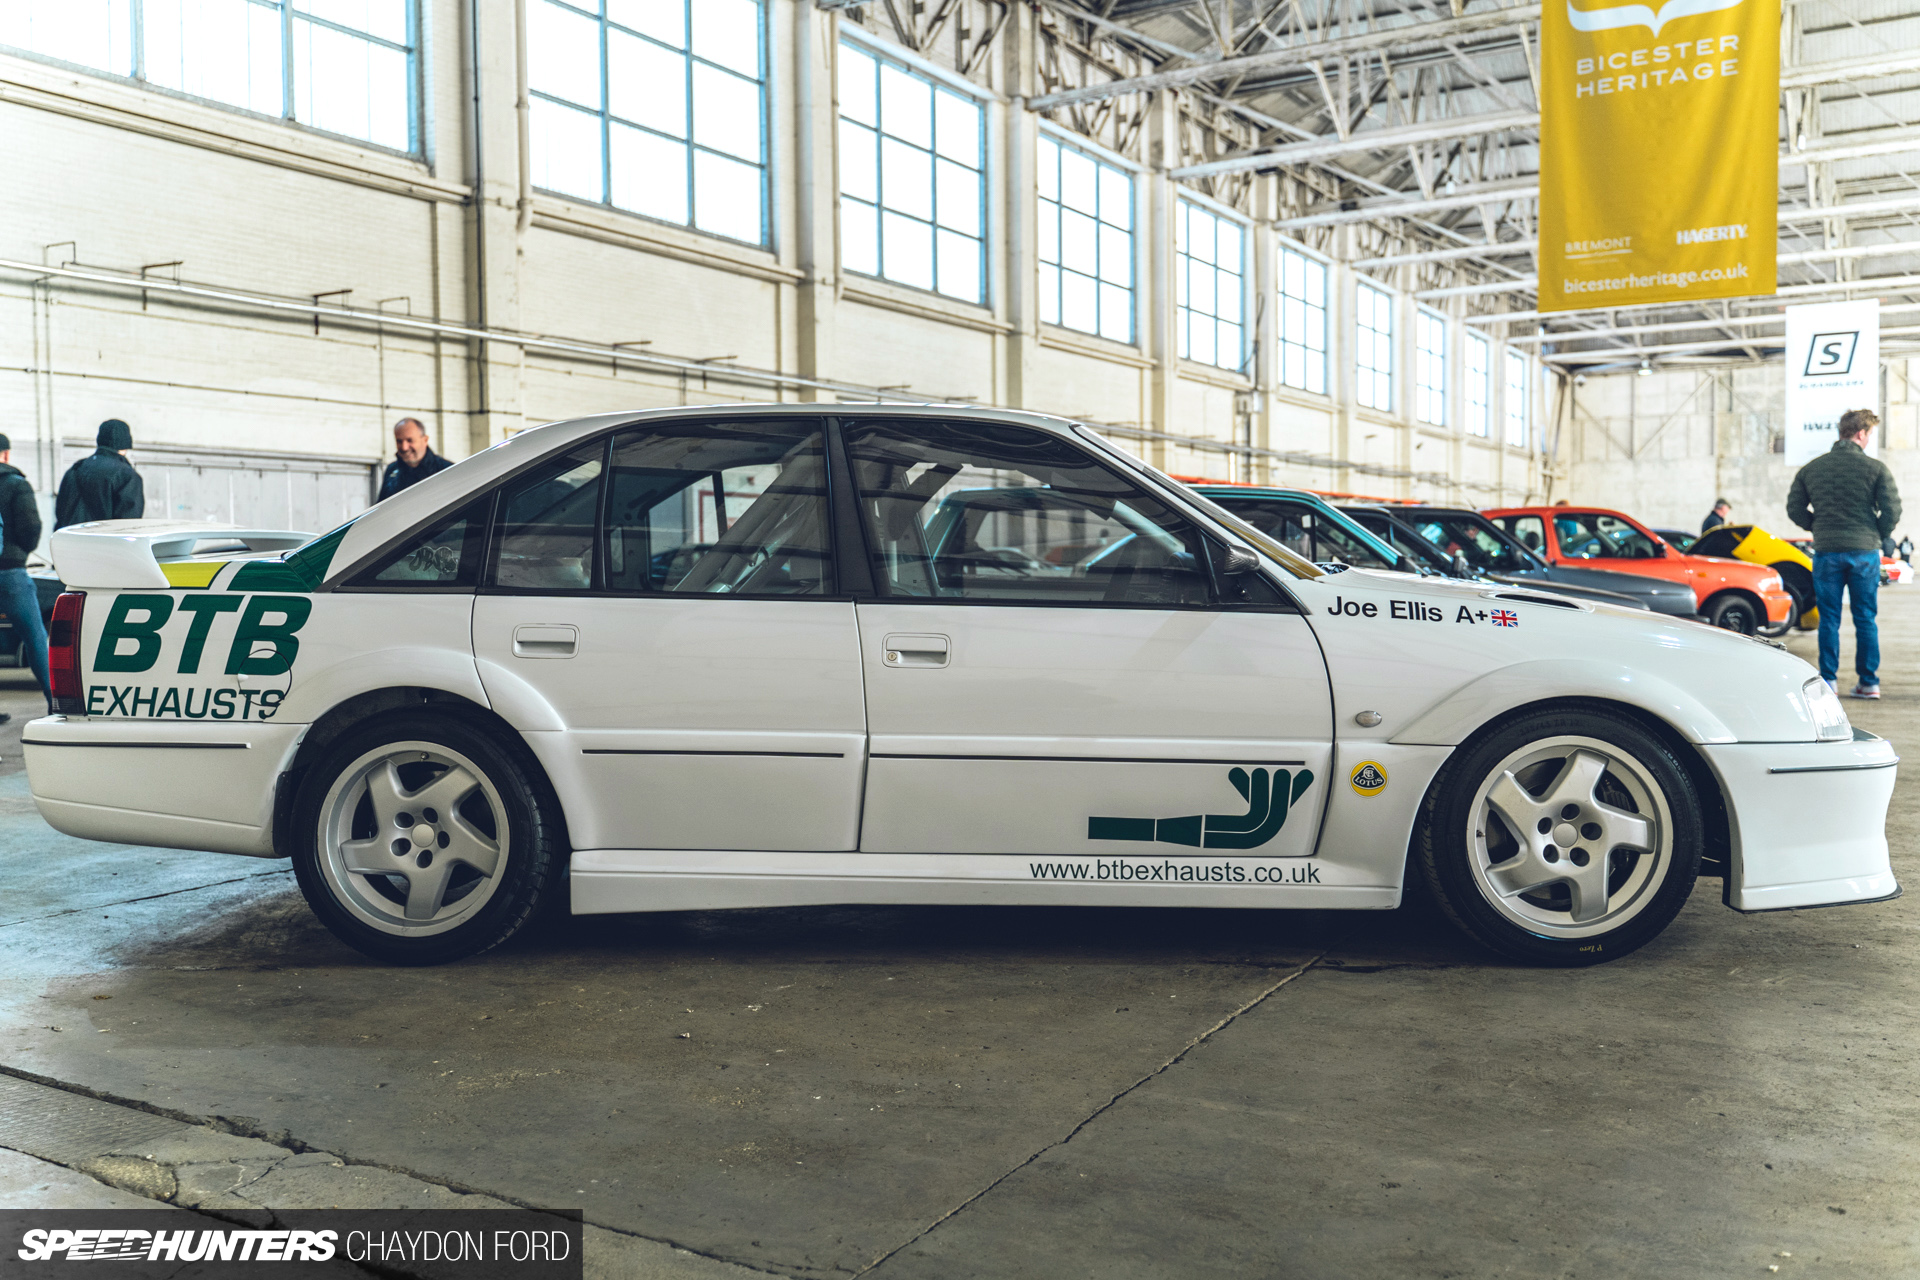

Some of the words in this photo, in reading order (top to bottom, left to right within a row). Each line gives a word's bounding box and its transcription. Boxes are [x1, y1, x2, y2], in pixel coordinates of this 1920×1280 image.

[1576, 34, 1739, 76] BICESTER
[1576, 58, 1739, 99] HERITAGE
[1565, 236, 1632, 253] BREMONT
[1676, 224, 1747, 245] HAGERTY
[1563, 262, 1749, 294] bicesterheritage.co.uk
[1327, 595, 1378, 618] Joe
[1390, 599, 1443, 622] Ellis
[1455, 605, 1488, 624] A+
[93, 593, 313, 676] BTB
[86, 685, 286, 720] EXHAUSTS
[1354, 776, 1384, 786] LOTUS
[1029, 859, 1321, 884] www.btbexhausts.co.uk
